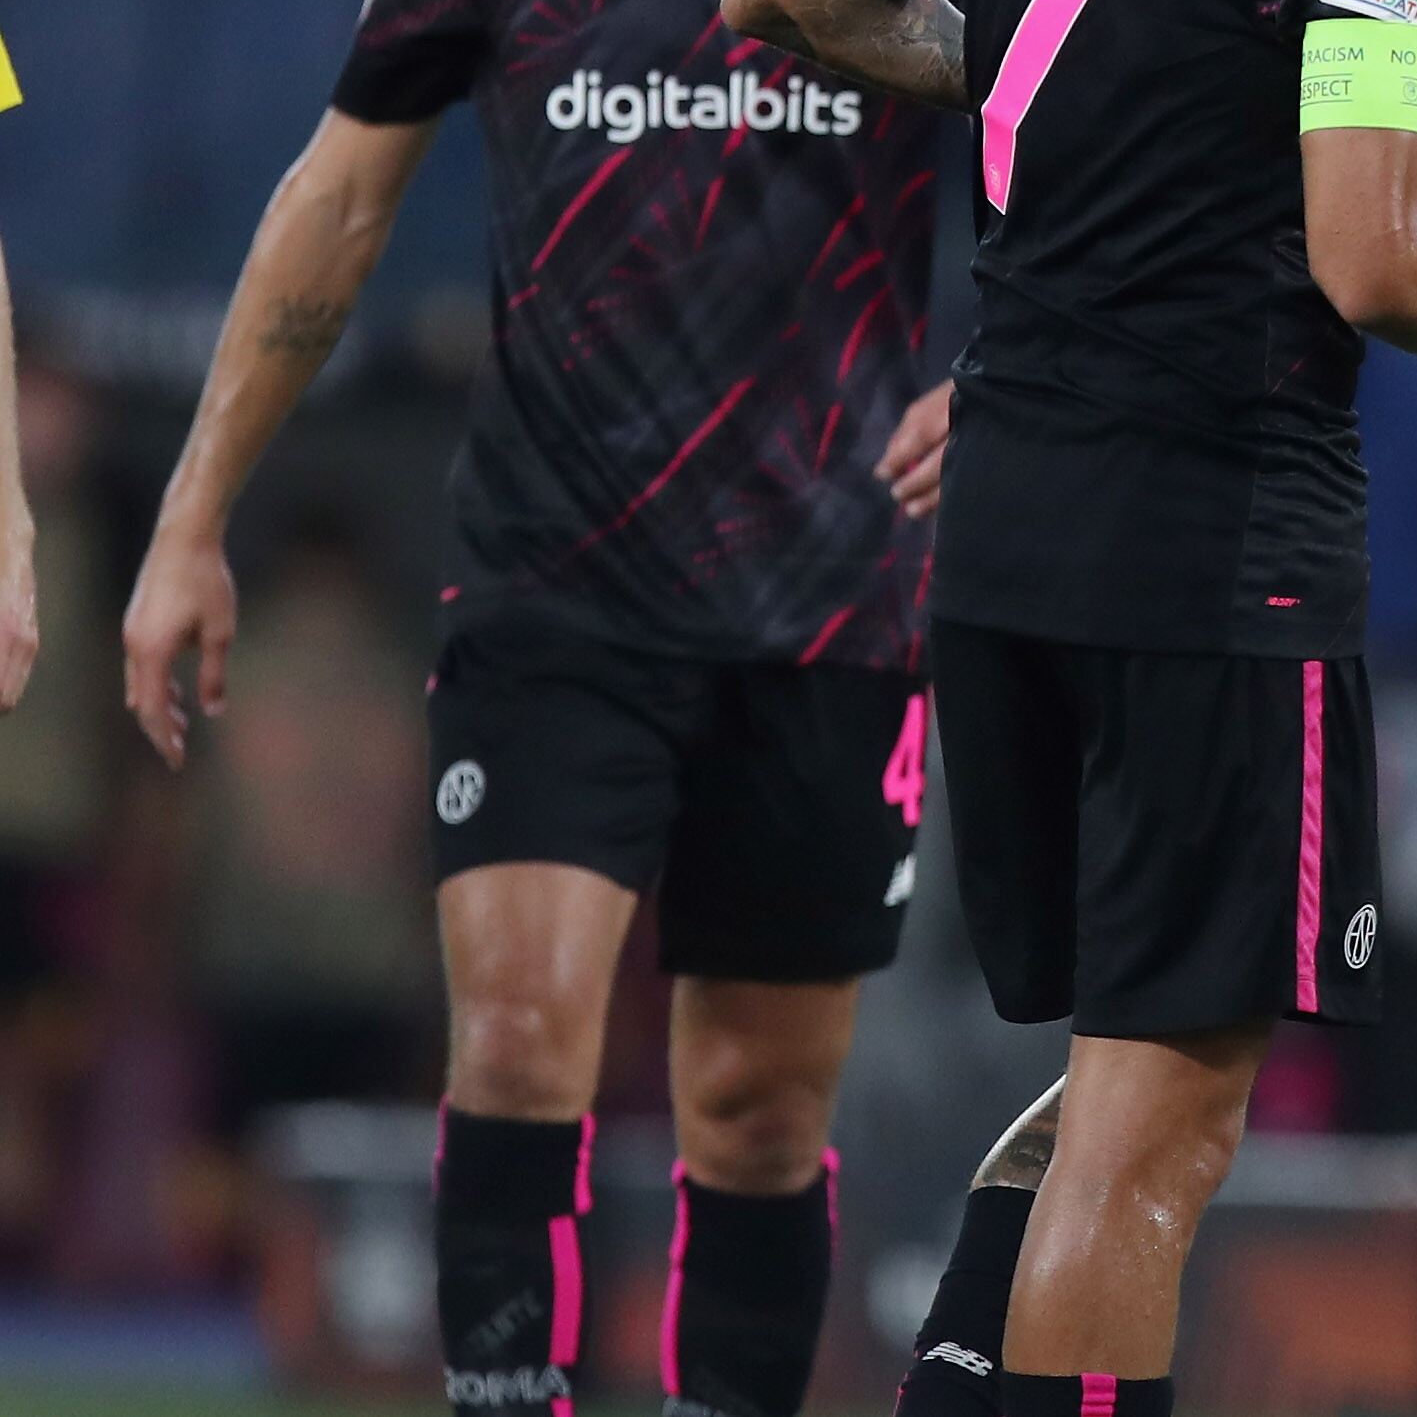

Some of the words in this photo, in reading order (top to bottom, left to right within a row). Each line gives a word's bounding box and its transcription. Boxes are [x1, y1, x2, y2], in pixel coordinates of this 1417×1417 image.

[1307, 46, 1364, 64] RACISM
[1390, 49, 1416, 65] NO
[1301, 79, 1353, 101] ESPECT
[546, 69, 863, 144] digitalbits
